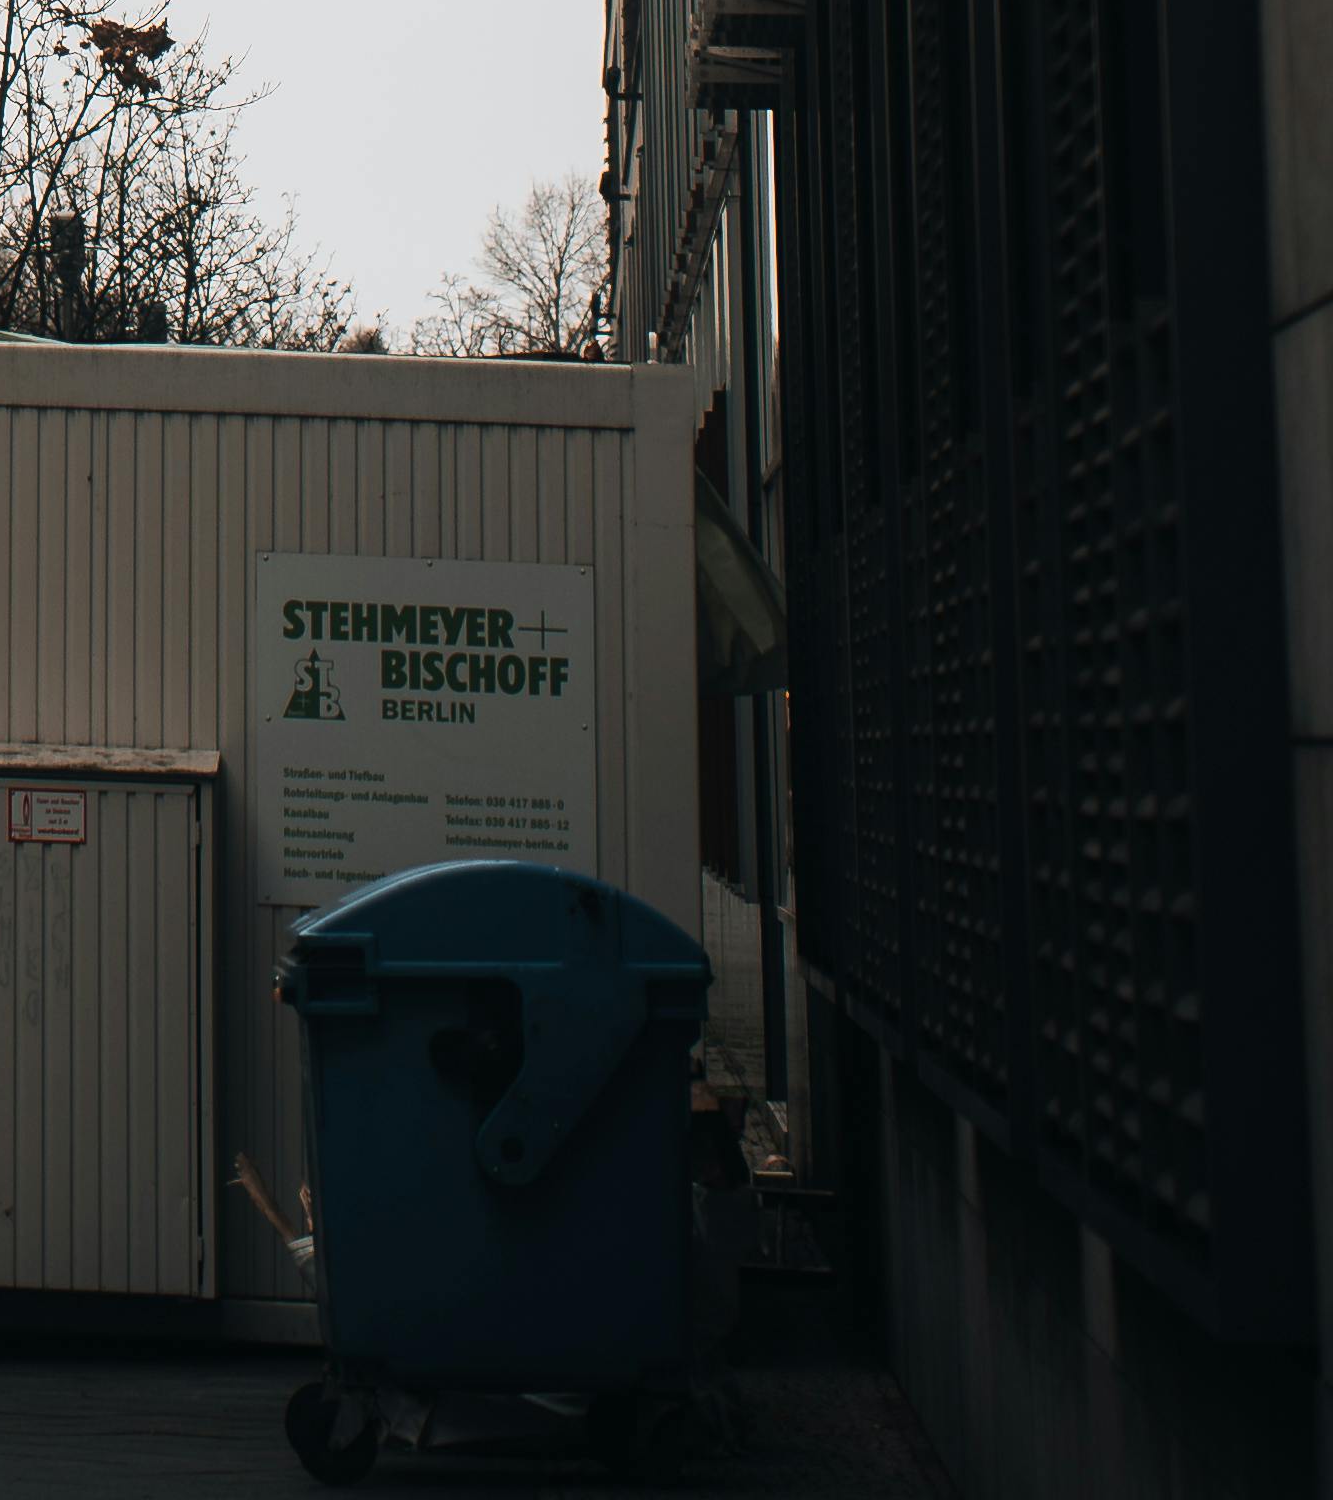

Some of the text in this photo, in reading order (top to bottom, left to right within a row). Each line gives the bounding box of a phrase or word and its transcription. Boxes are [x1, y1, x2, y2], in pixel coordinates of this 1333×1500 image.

[282, 600, 515, 648] STEHMEYER
[381, 650, 569, 697] BISCHOFF
[382, 699, 475, 724] BERLIN
[283, 767, 385, 781] Straßen- und Tiefbau
[351, 791, 370, 801] und
[371, 791, 429, 804] Anlagenbau
[486, 796, 506, 808] 030
[508, 798, 528, 809] 417
[283, 807, 330, 819] Kanalbau
[485, 816, 505, 828] 030
[507, 818, 527, 828] 417
[283, 827, 355, 842] Rohrsanierung
[283, 847, 345, 860] Rohrvortrieb
[283, 867, 312, 879] Hoch-
[315, 869, 334, 880] und
